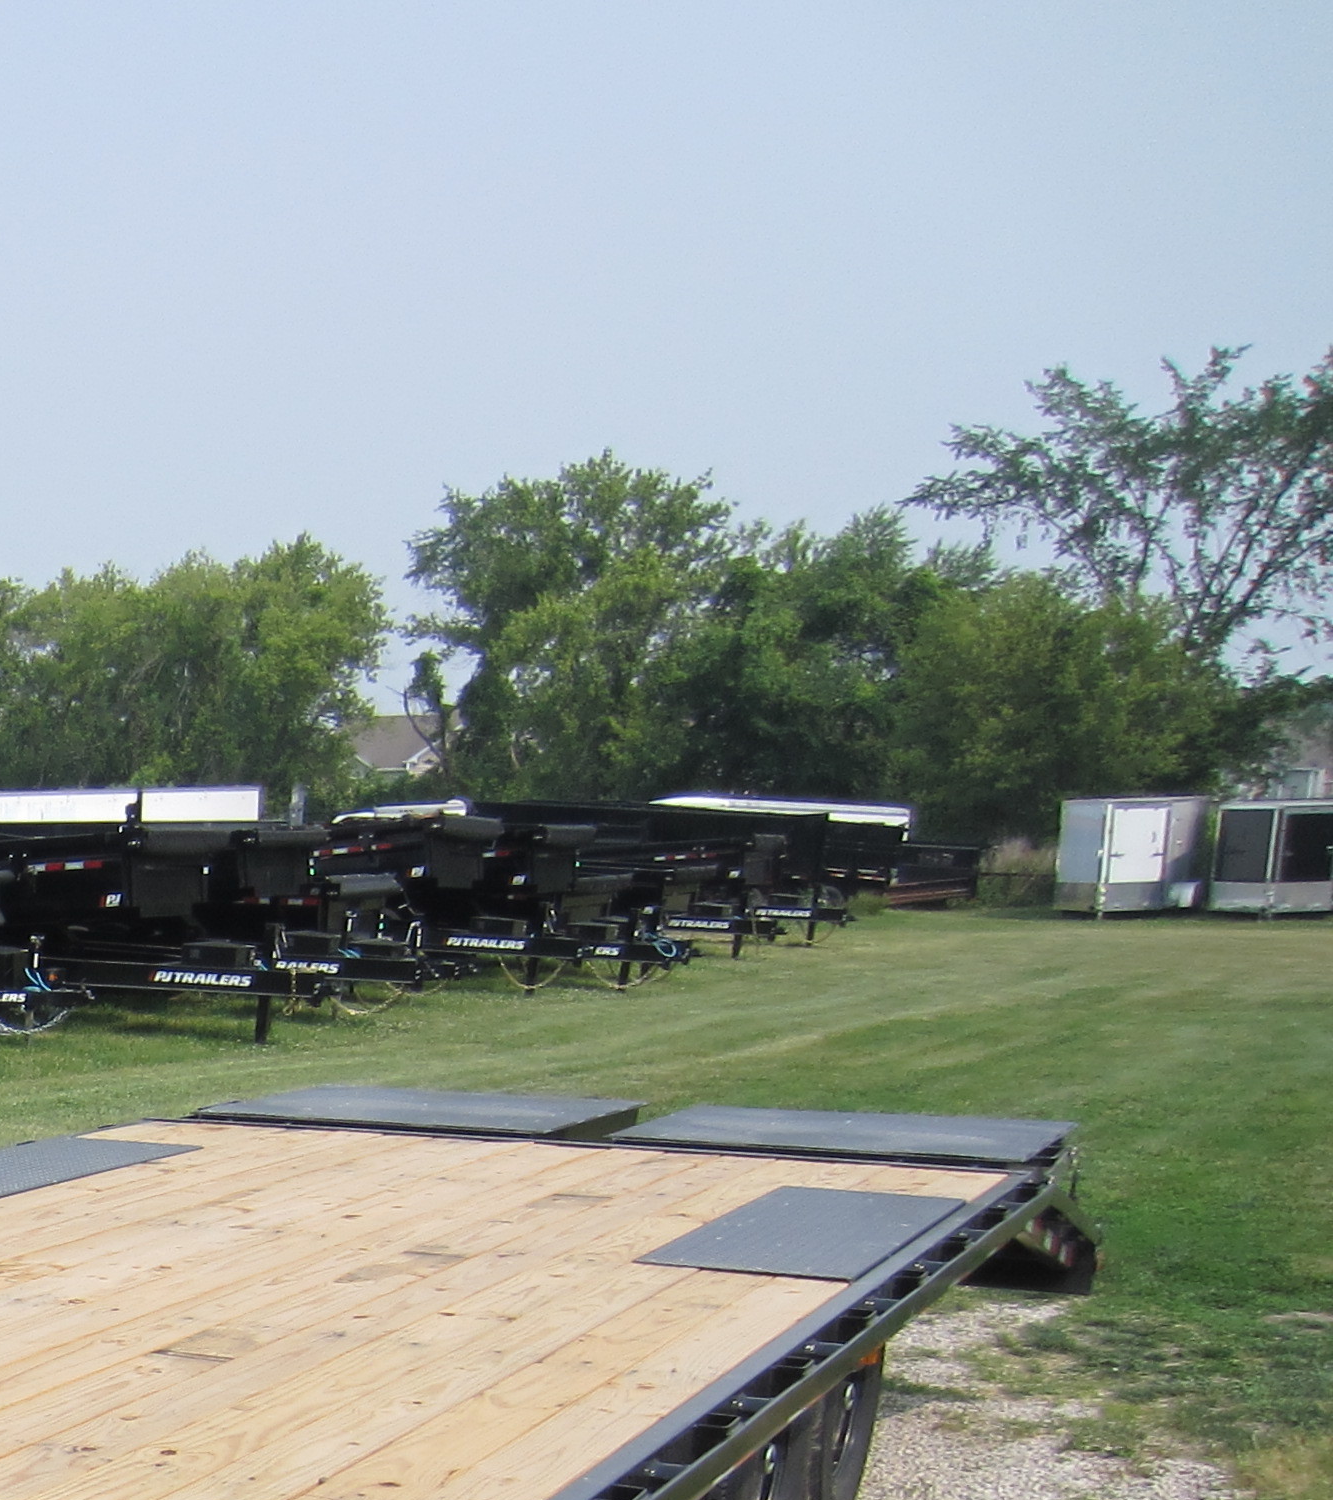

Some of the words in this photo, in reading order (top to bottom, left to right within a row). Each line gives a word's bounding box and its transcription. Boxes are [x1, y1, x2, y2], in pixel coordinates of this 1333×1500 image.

[105, 893, 122, 908] PJ
[461, 937, 526, 950] TRAILERS
[153, 969, 174, 984] PJ
[173, 971, 253, 988] TRAILERS
